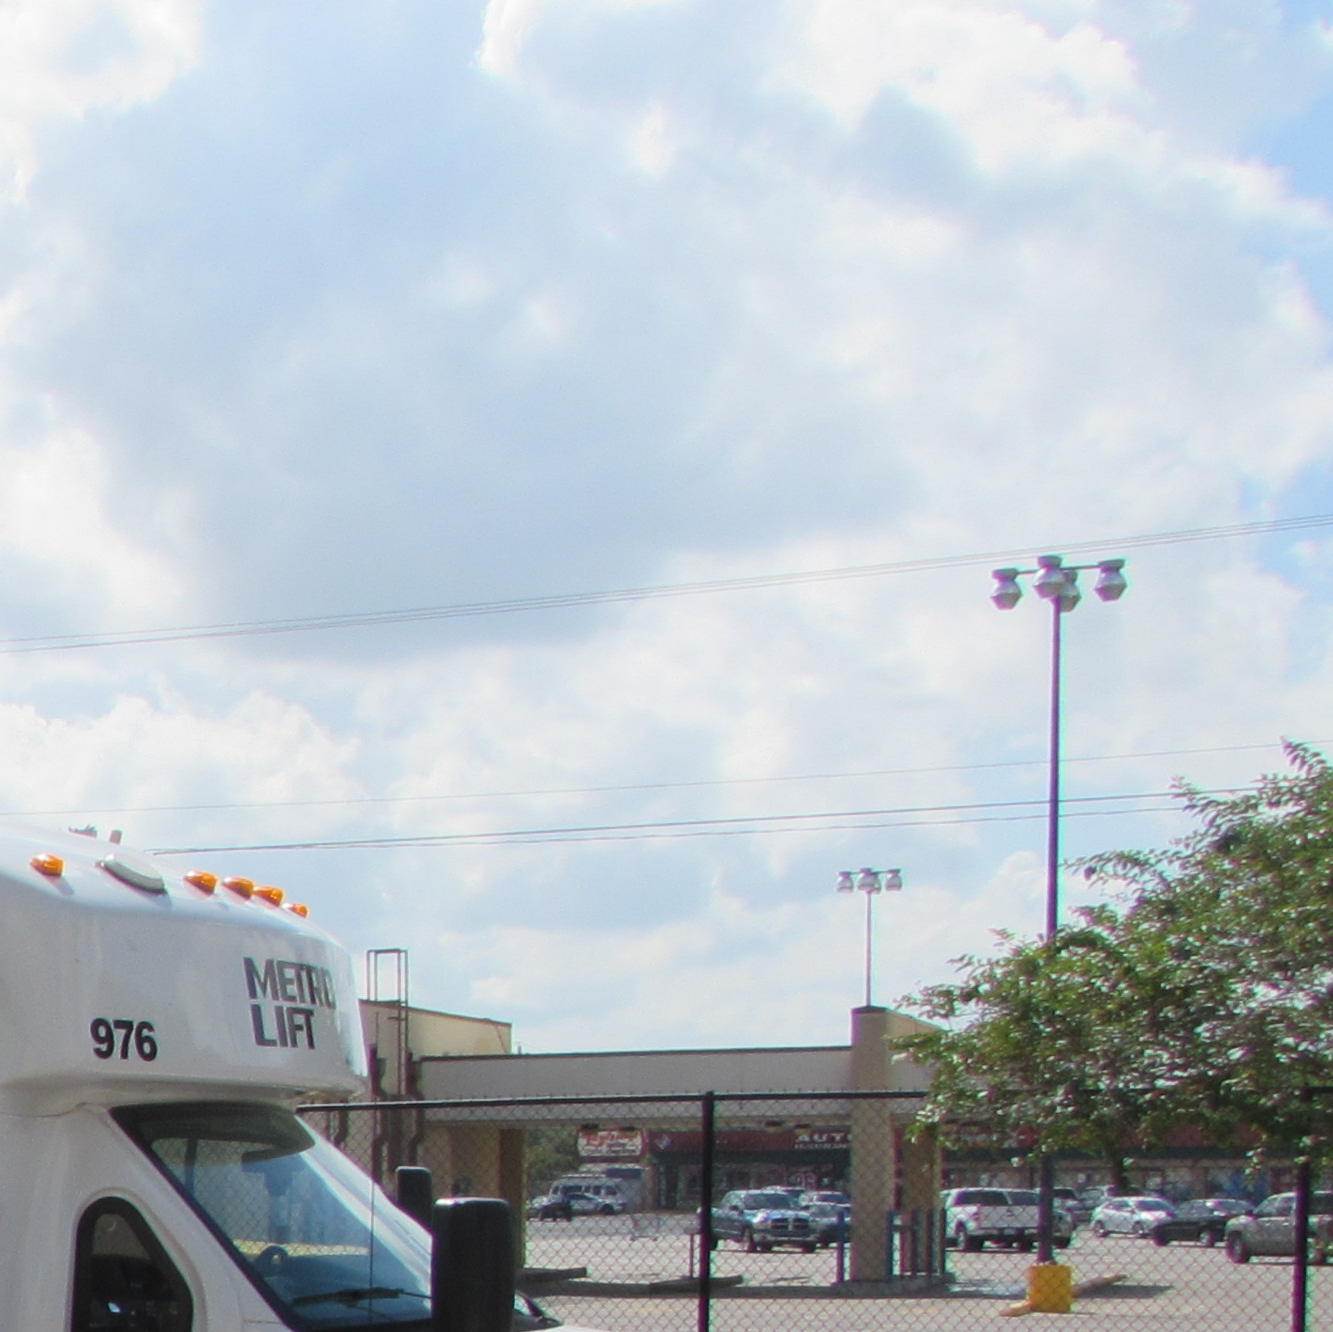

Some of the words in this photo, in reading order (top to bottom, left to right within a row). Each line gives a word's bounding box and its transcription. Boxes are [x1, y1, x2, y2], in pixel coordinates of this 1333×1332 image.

[243, 956, 336, 1010] METRO
[90, 1017, 158, 1061] 976
[250, 1003, 316, 1050] LIFT
